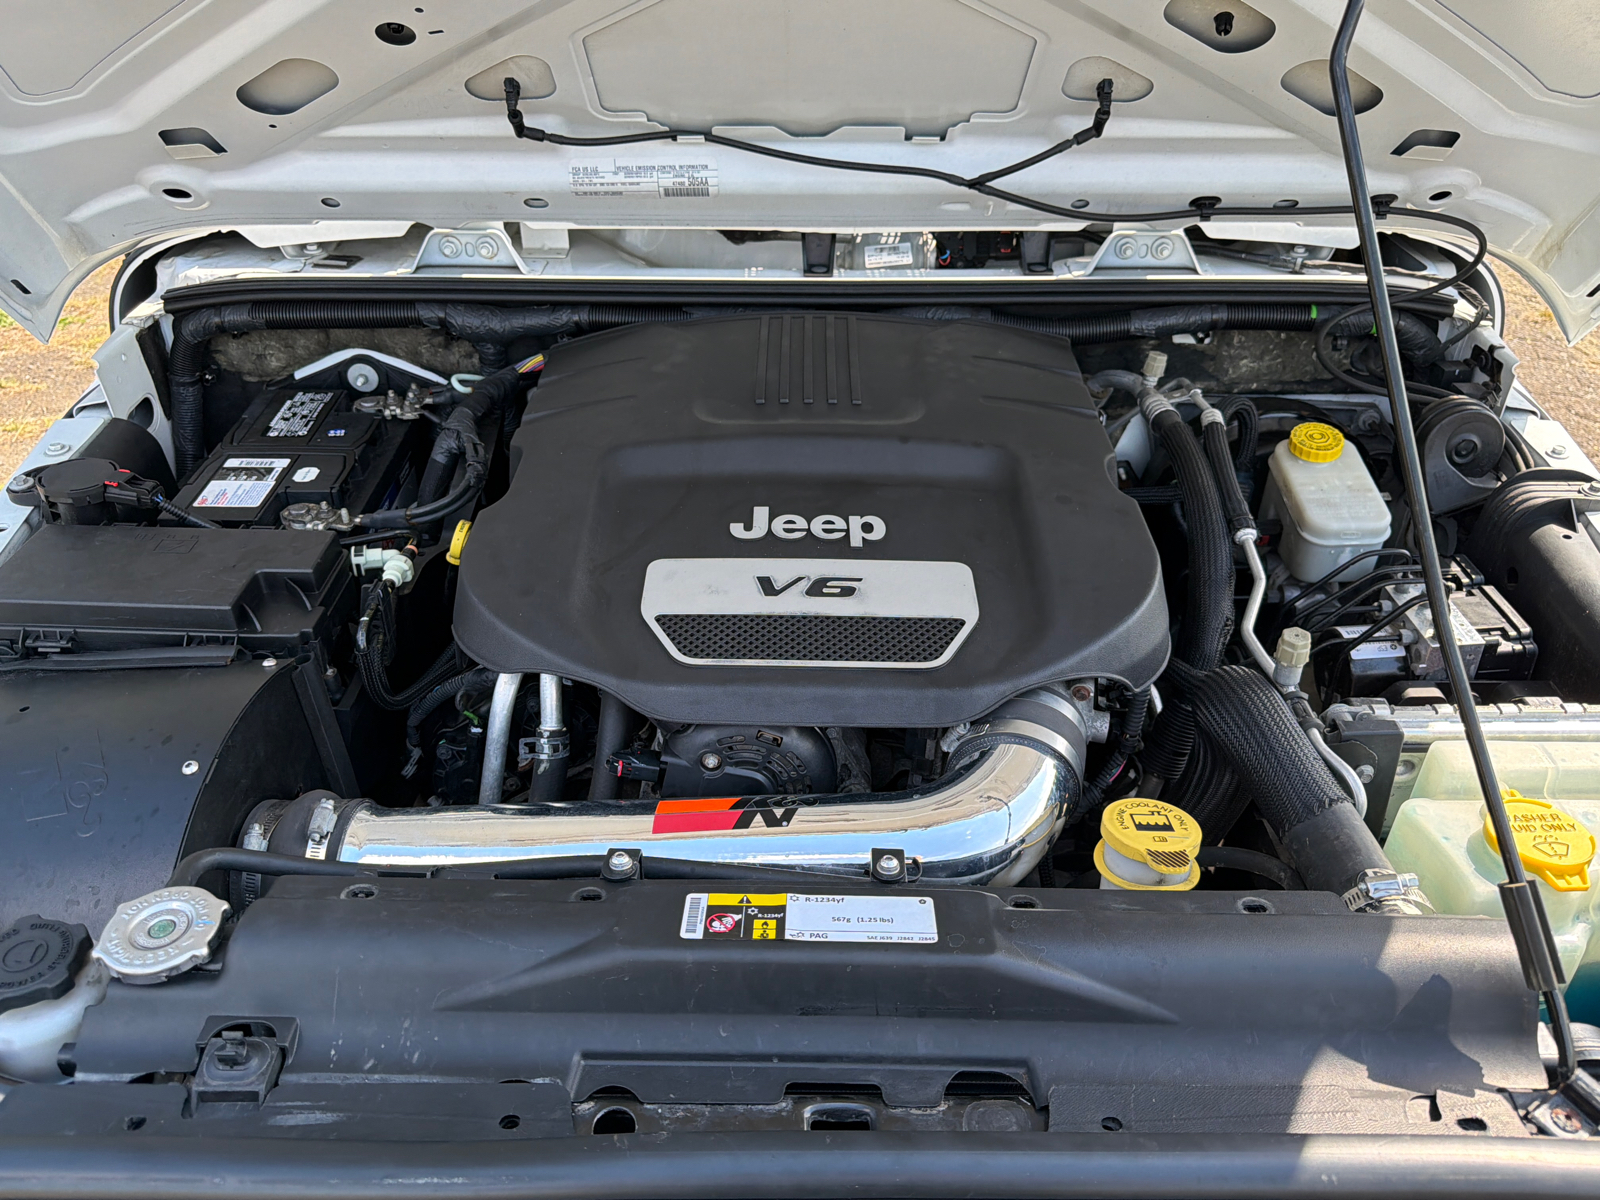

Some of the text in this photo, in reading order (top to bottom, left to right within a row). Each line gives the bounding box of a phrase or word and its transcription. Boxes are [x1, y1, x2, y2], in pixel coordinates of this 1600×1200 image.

[687, 177, 710, 187] 505AA
[729, 505, 888, 549] Jeep
[754, 575, 864, 599] V6
[1115, 802, 1189, 832] ENGINE COOLANT ONLY
[1540, 823, 1577, 832] ONLY
[804, 896, 845, 904] R-1234yf
[856, 916, 878, 924] (1.25
